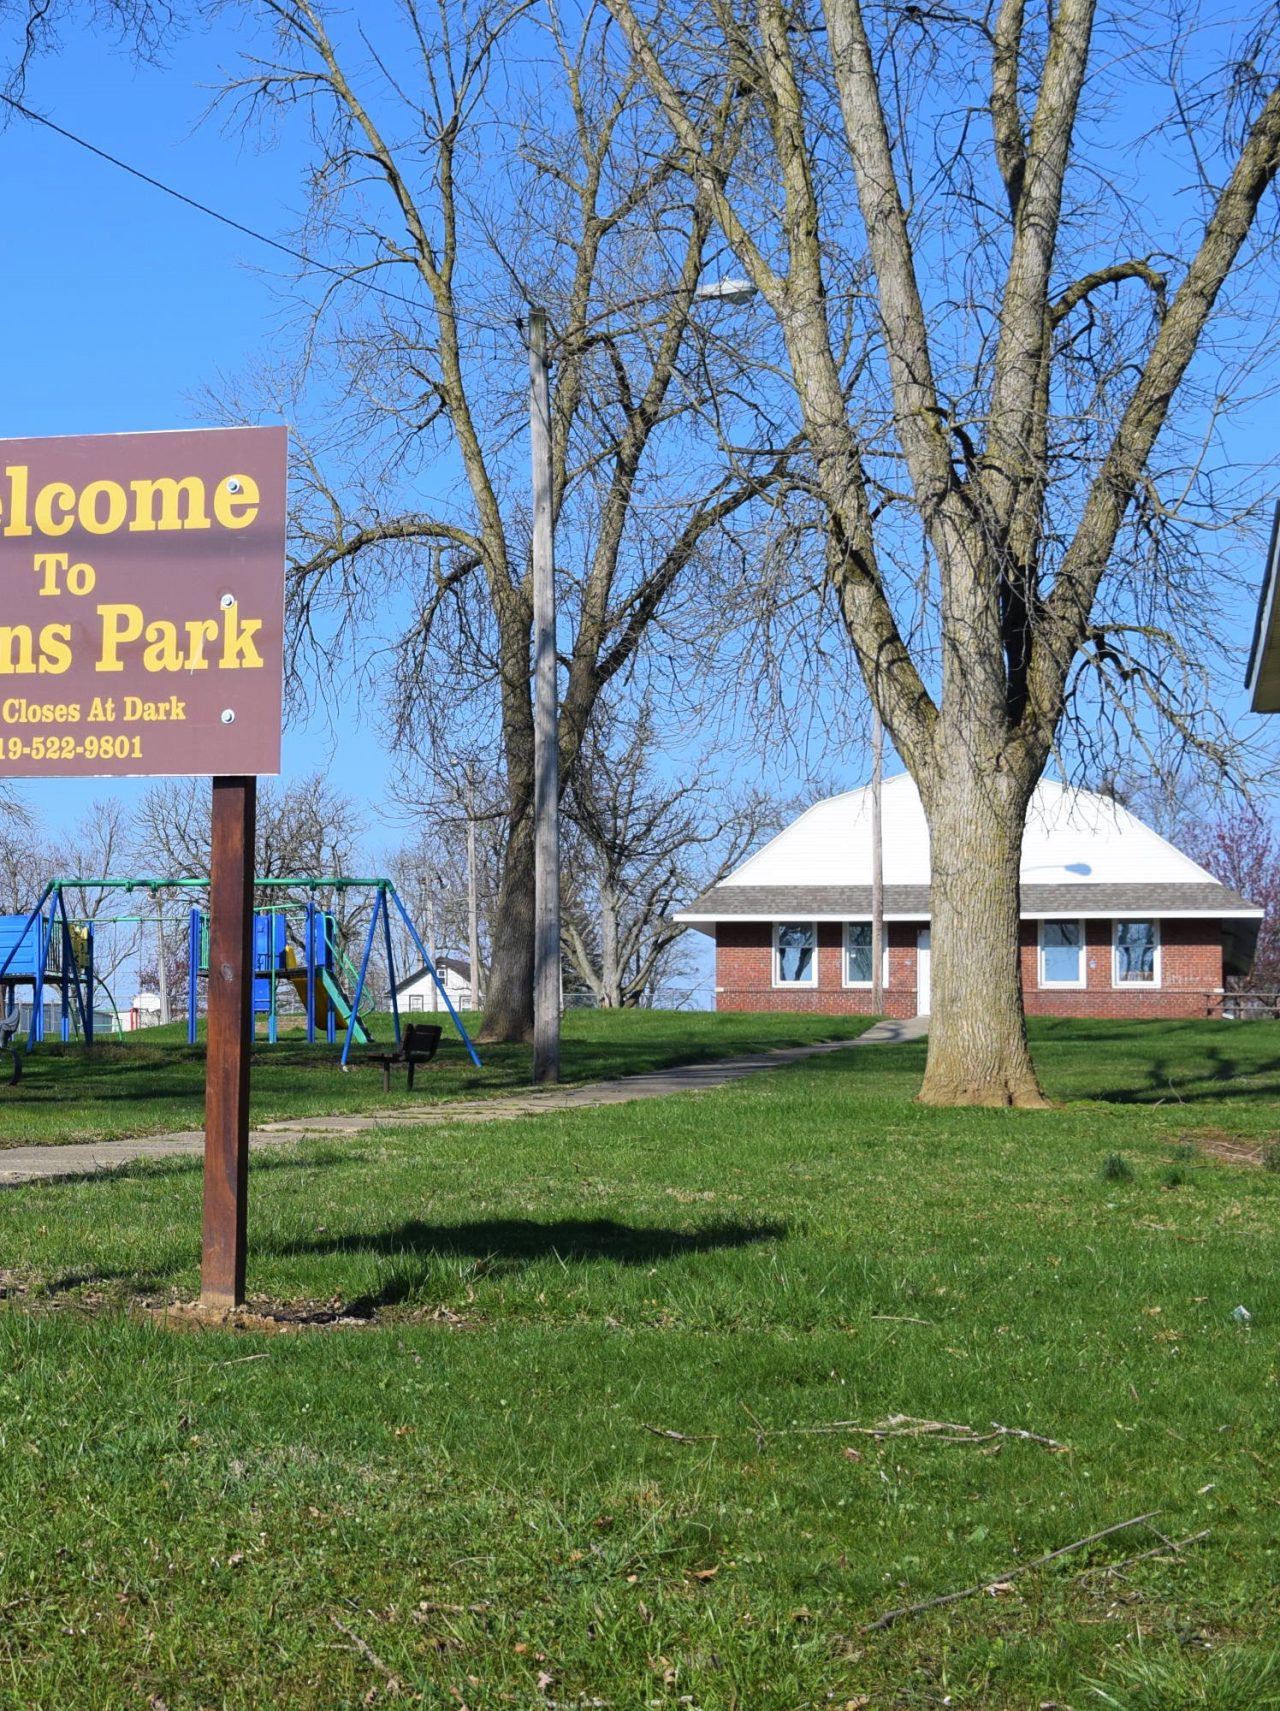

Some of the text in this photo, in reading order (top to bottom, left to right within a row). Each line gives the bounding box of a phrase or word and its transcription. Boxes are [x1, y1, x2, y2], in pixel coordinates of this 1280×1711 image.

[33, 552, 96, 596] To
[95, 601, 264, 673] Park
[1, 697, 80, 724] Closes
[86, 697, 115, 722] At
[124, 695, 186, 721] Dark
